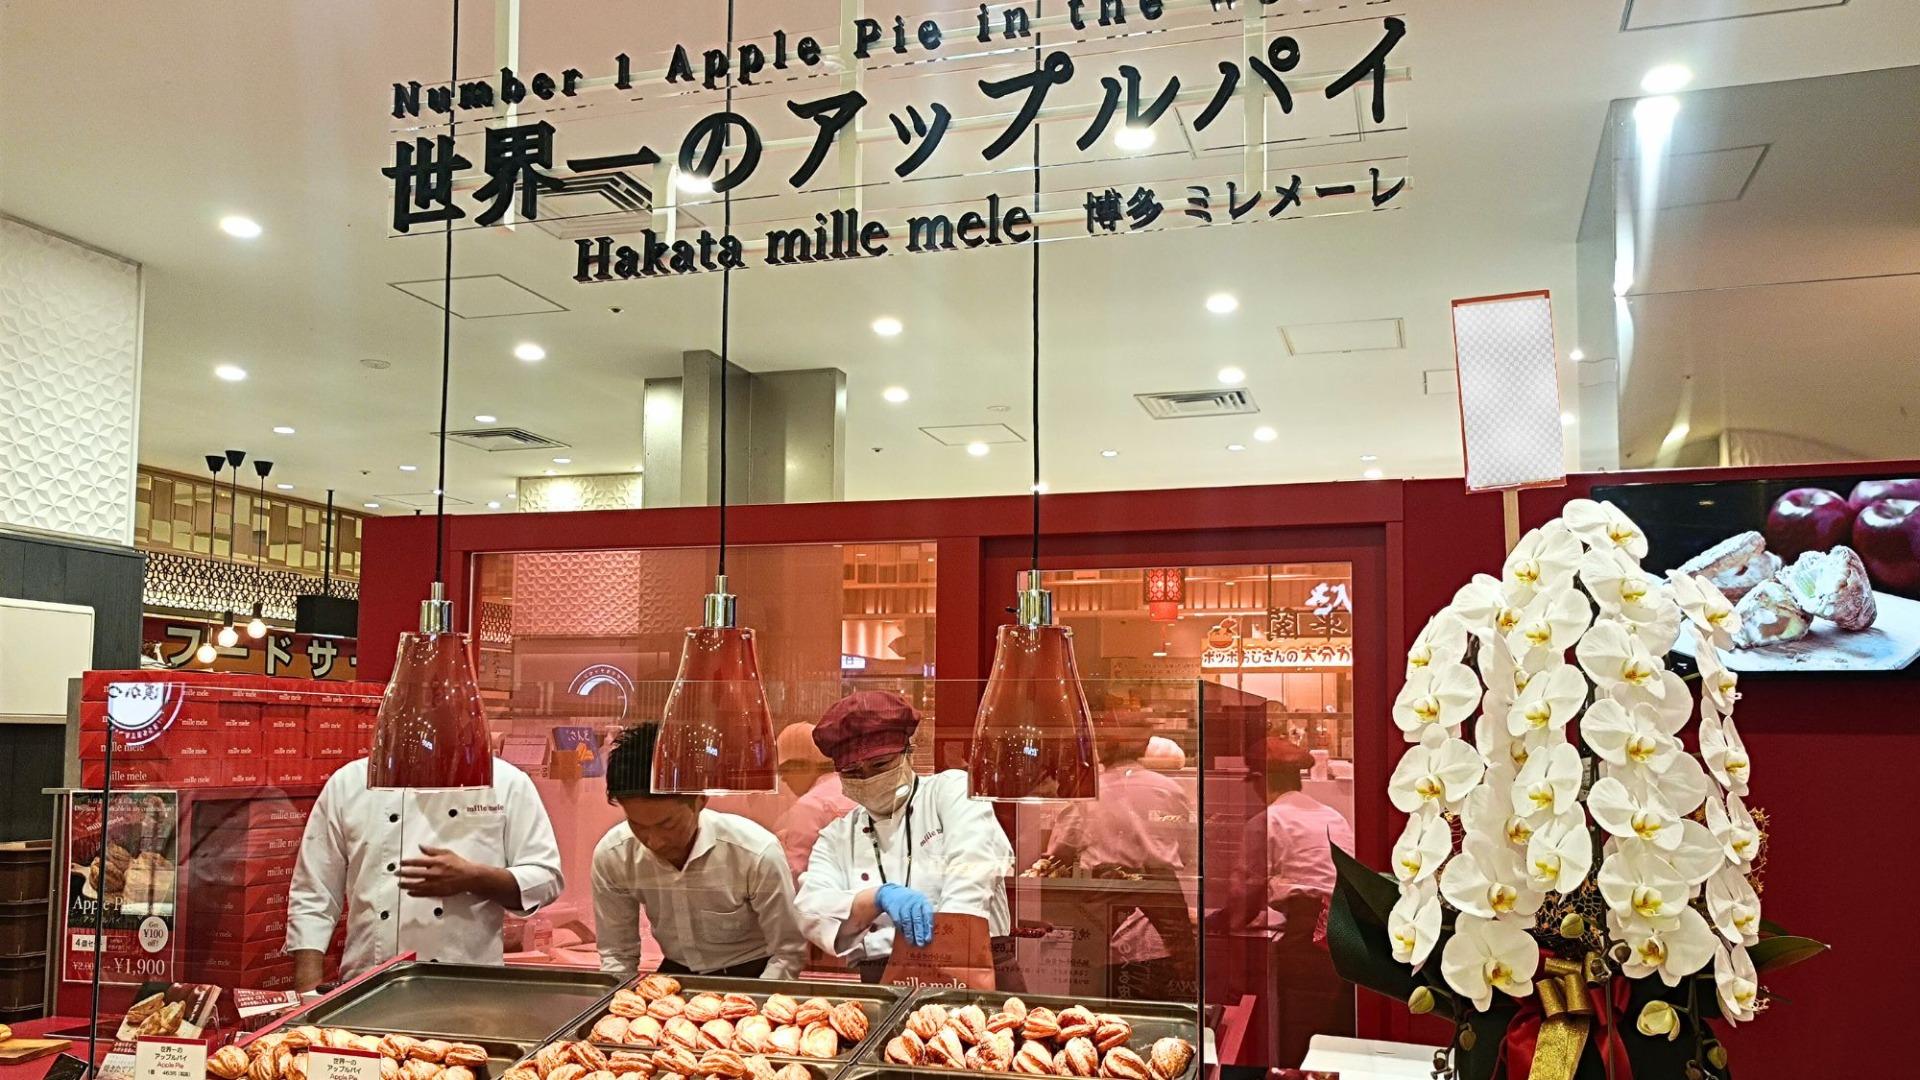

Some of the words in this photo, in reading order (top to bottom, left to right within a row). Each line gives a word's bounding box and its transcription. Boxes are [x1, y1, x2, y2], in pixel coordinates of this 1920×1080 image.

[391, 67, 583, 118] Number
[614, 53, 632, 91] 1
[665, 29, 823, 90] Apple
[853, 15, 942, 58] Pie
[976, 3, 1032, 43] in
[1067, 0, 1164, 31] the
[381, 16, 1406, 234] 世界一のアップルパイ
[1083, 185, 1164, 236] 博多
[1184, 167, 1406, 222] ミレメーレ
[573, 228, 745, 283] Hakata
[764, 208, 890, 265] mille
[906, 194, 1033, 253] mele
[167, 626, 356, 677] フードサ
[101, 742, 122, 752] mlle
[73, 896, 110, 914] Appe
[143, 928, 164, 938] ¥100
[114, 958, 165, 976] ¥1,900
